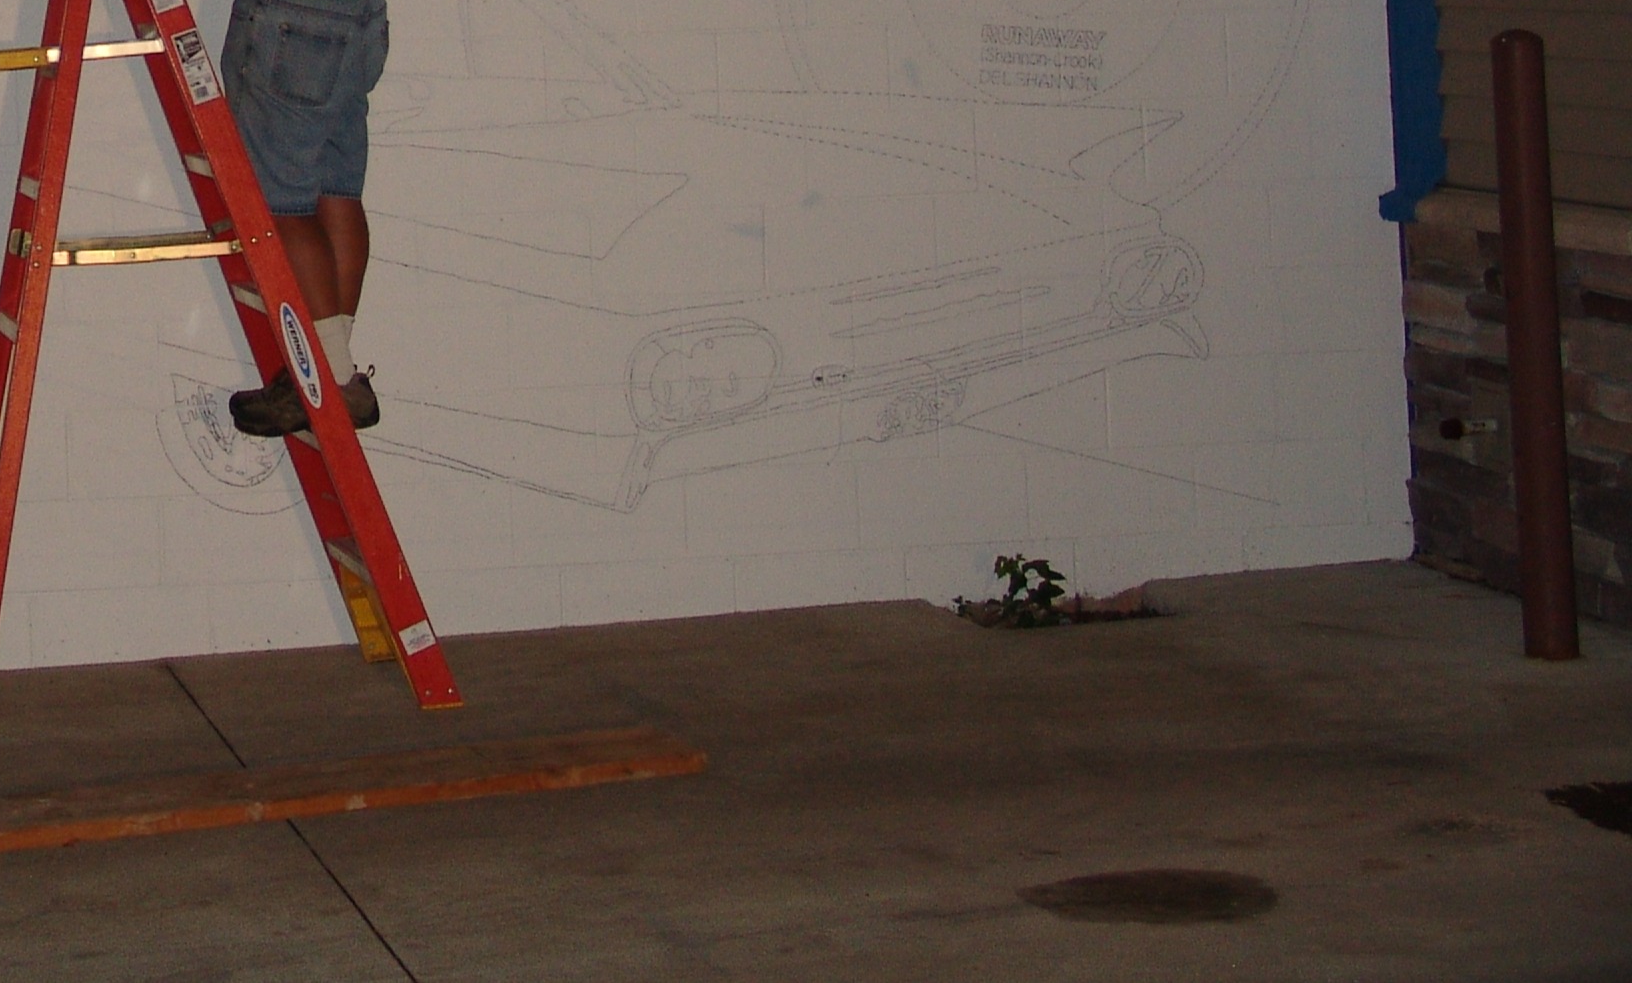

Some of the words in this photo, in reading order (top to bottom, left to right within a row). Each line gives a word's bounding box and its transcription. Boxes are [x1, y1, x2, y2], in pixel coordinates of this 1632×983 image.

[981, 24, 1107, 50] RUNAWAY
[1016, 72, 1098, 91] SHANNON
[286, 320, 307, 365] WERNER
